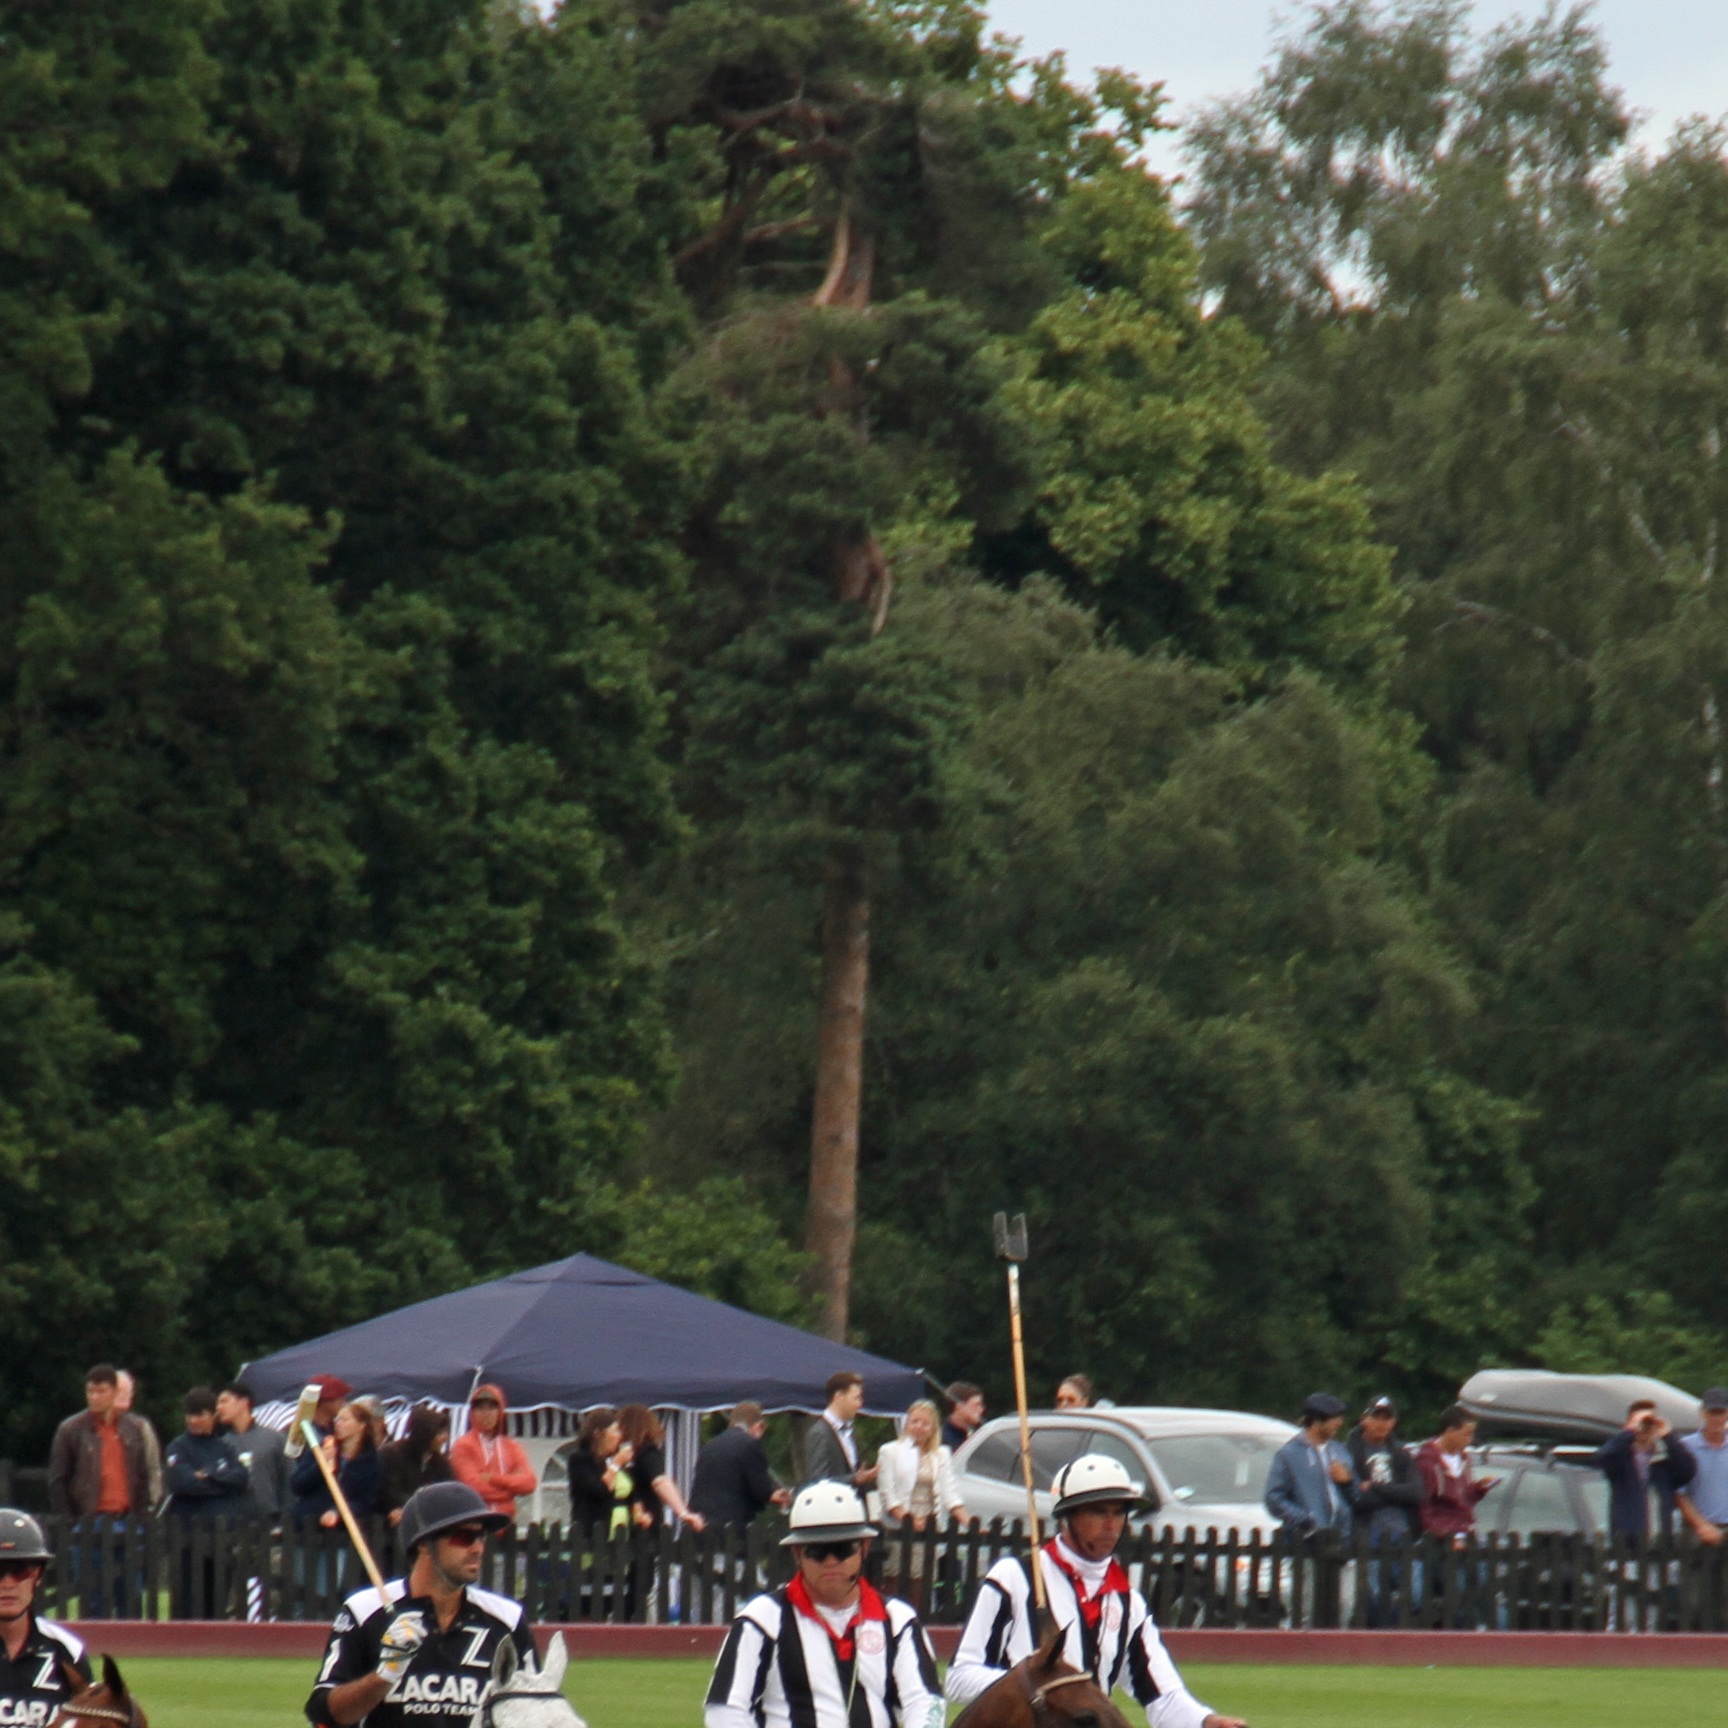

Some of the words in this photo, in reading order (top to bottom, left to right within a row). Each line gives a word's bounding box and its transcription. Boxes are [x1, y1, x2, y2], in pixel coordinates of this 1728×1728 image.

[459, 1625, 491, 1668] Z
[31, 1651, 60, 1691] Z
[403, 1703, 441, 1715] POLO
